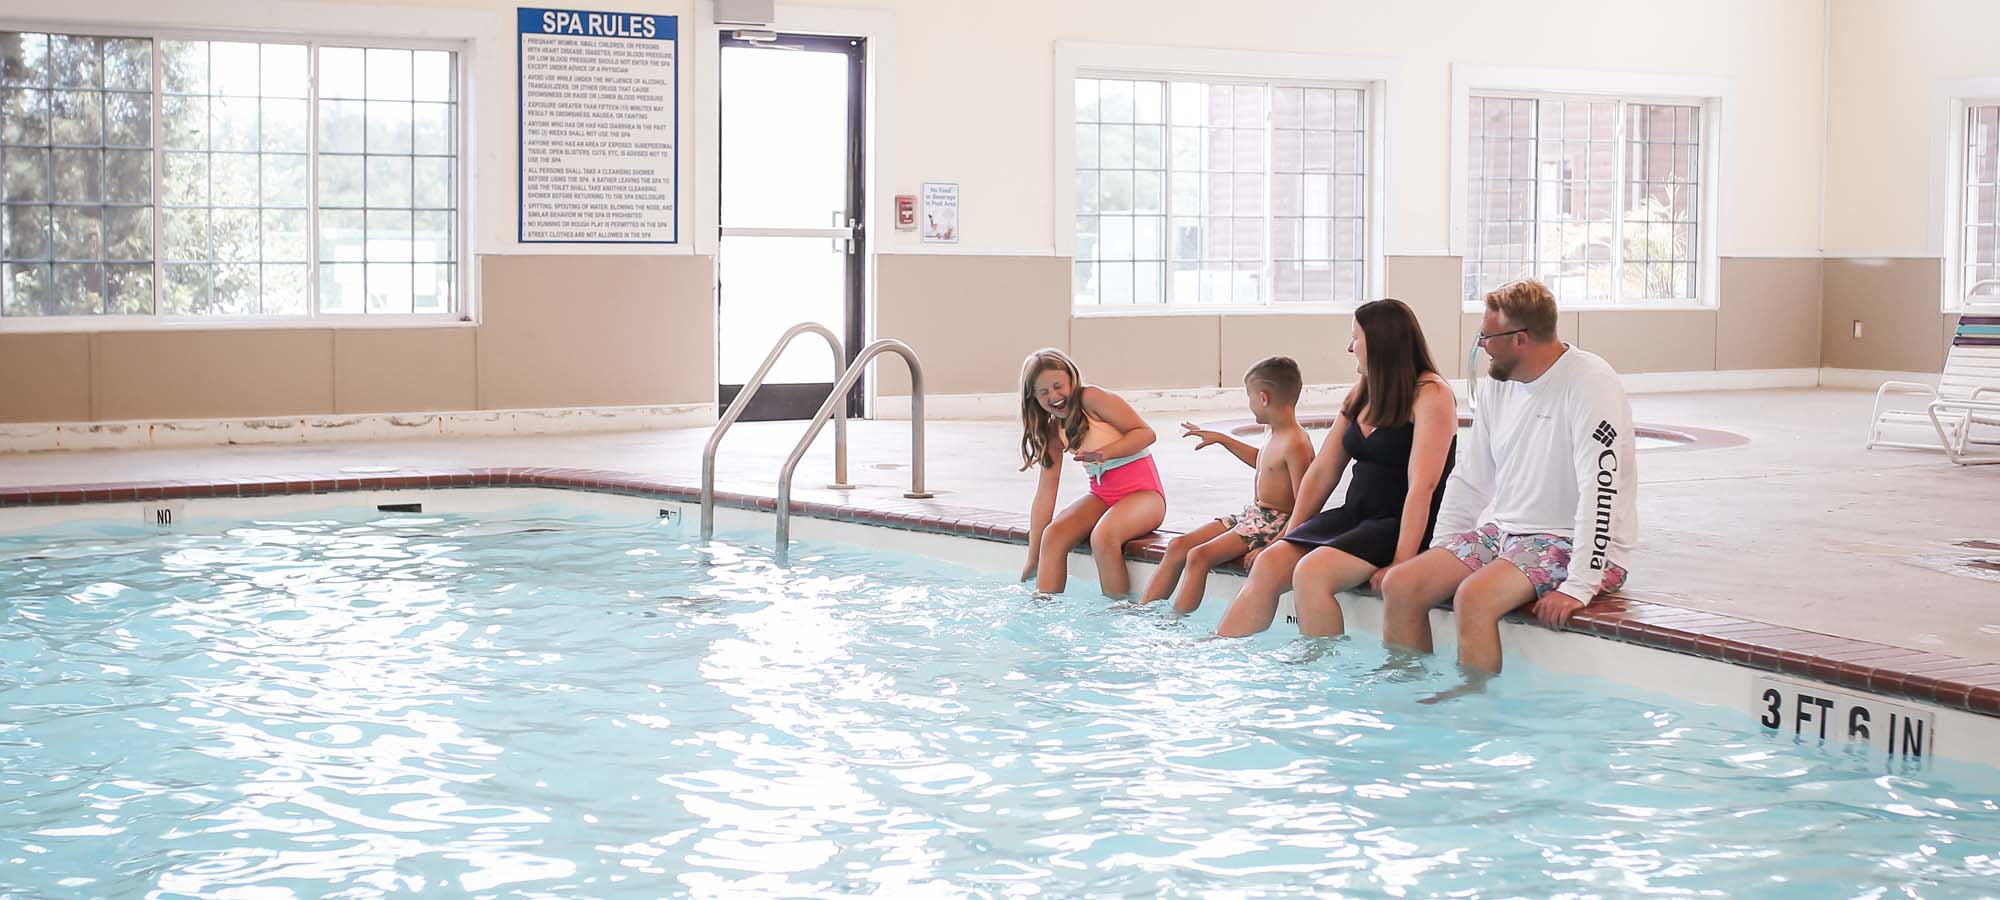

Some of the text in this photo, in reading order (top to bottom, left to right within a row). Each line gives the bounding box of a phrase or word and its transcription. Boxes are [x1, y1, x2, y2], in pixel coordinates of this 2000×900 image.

[543, 12, 656, 38] SPA RULES
[1590, 449, 1618, 571] Columbia
[1761, 688, 1782, 730] 3
[1795, 694, 1834, 740] FT
[1888, 713, 1924, 758] IN
